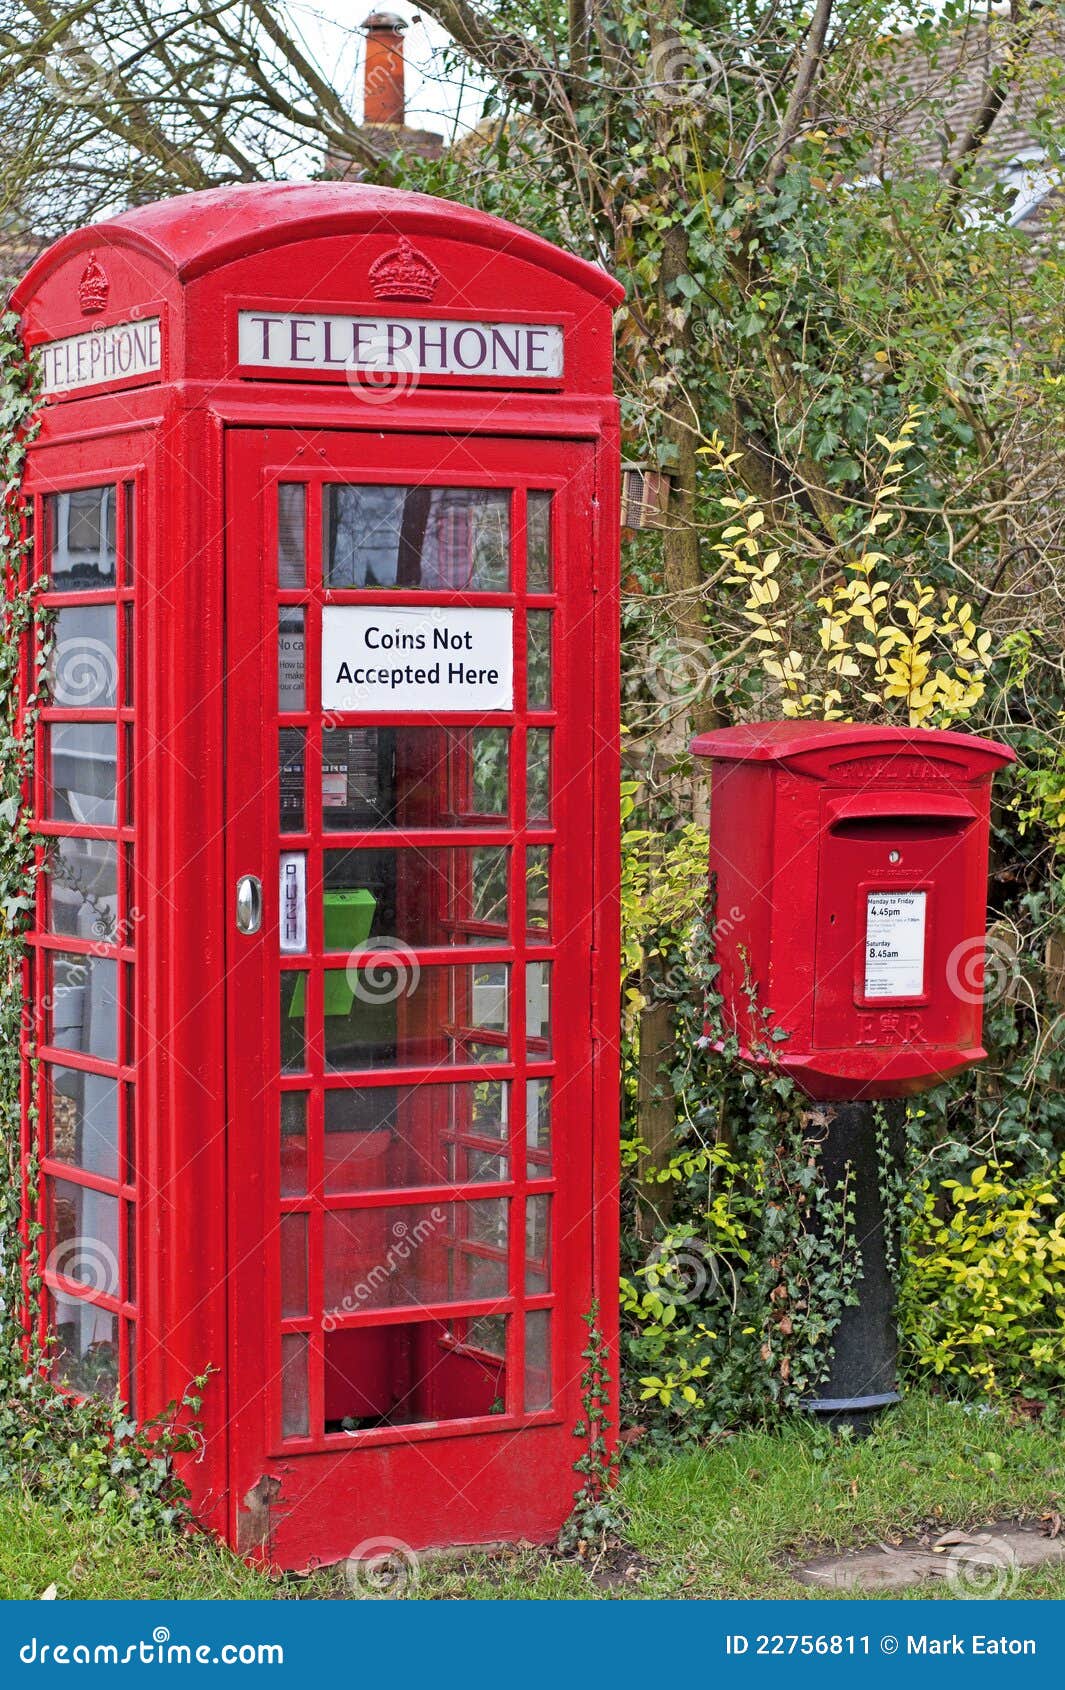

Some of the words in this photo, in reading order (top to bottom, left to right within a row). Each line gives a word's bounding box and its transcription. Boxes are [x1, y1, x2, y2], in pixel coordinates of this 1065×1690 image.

[250, 317, 550, 372] TELEPHONE
[41, 323, 159, 388] TELEPHONE
[364, 626, 426, 650] Coins
[433, 628, 473, 650] Not
[336, 661, 440, 689] Accepted
[448, 662, 499, 685] Here
[867, 898, 889, 906] Monday
[897, 897, 915, 905] Friday
[870, 906, 901, 918] 4.45pm
[866, 940, 891, 948] Saturday
[869, 947, 899, 959] 8.45am
